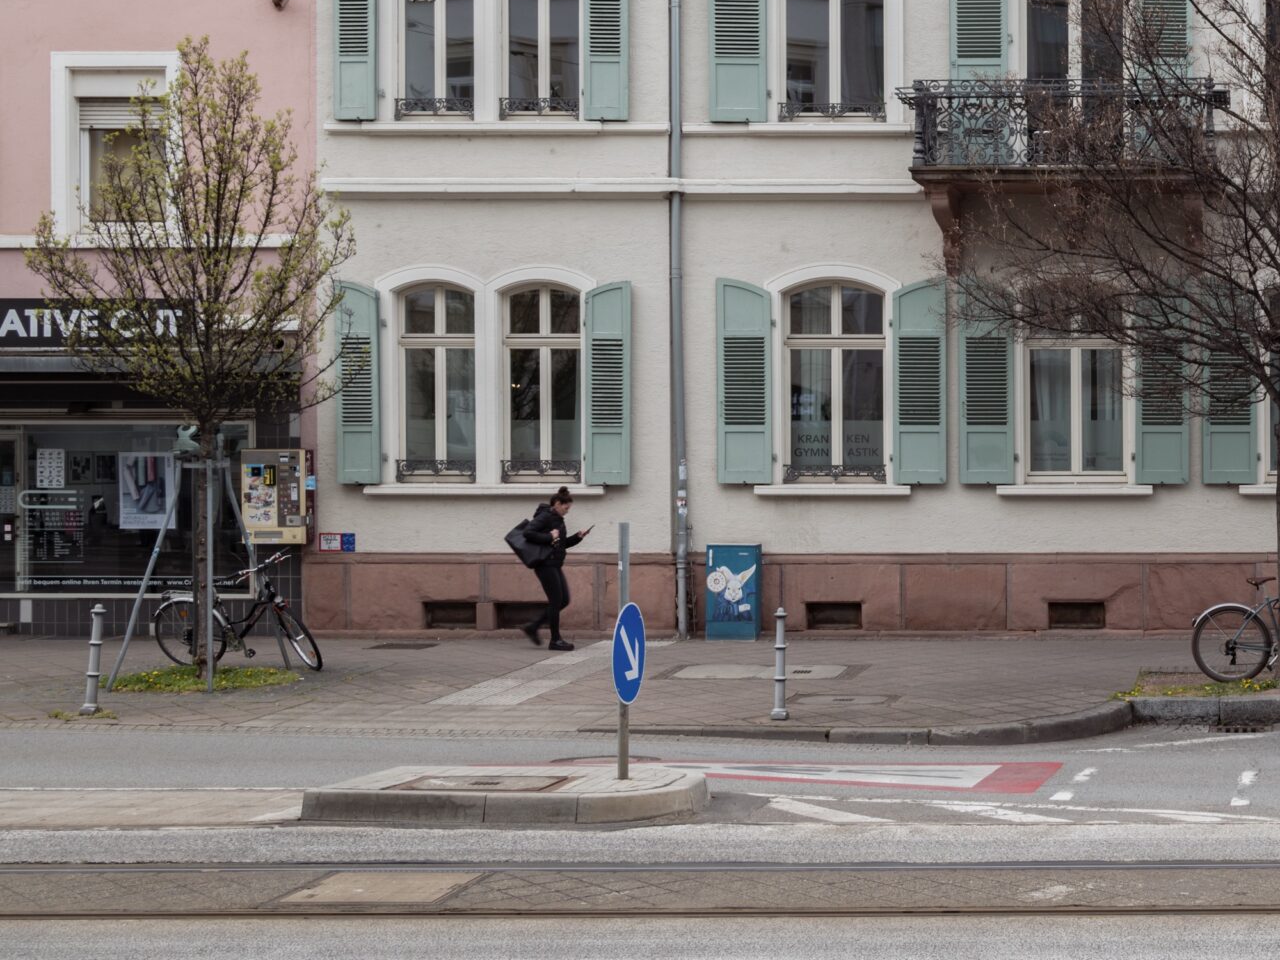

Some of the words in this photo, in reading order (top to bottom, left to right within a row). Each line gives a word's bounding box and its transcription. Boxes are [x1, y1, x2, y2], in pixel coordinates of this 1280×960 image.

[0, 309, 98, 338] ATIVE
[797, 434, 829, 443] KRAN
[846, 434, 870, 443] KEN
[793, 447, 829, 457] GYMN
[847, 447, 879, 457] ASTIK
[33, 579, 60, 587] bequem
